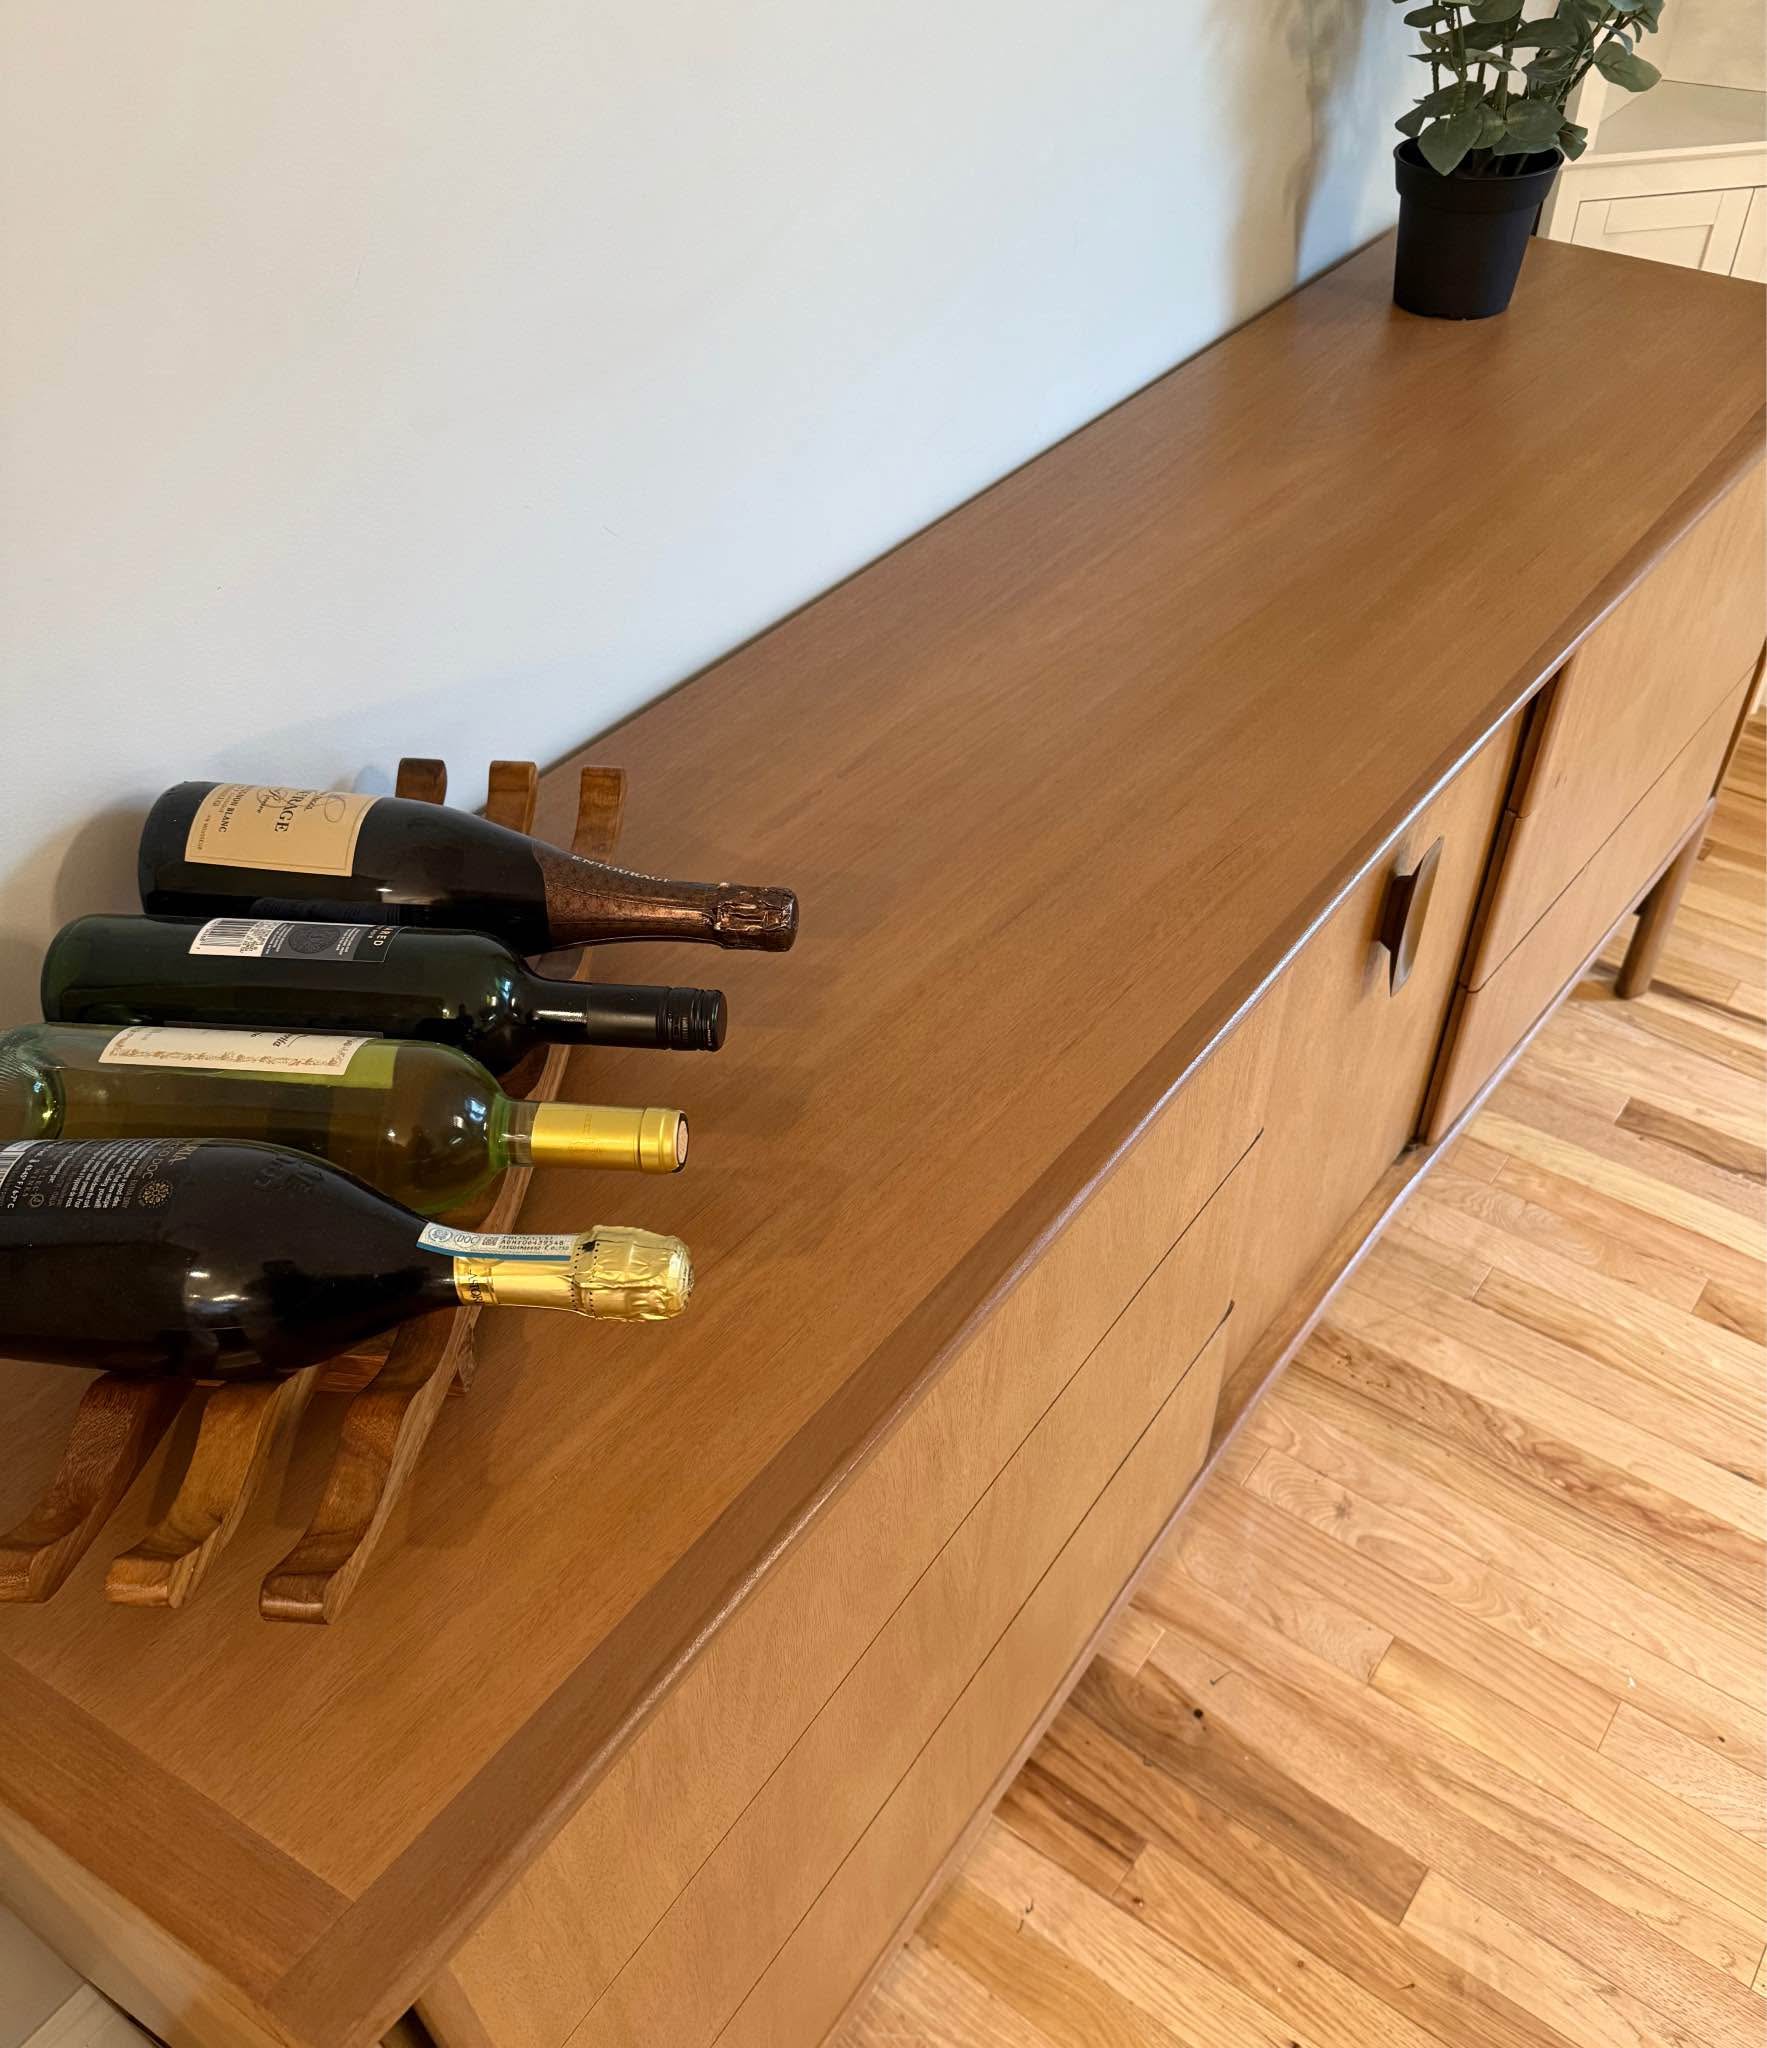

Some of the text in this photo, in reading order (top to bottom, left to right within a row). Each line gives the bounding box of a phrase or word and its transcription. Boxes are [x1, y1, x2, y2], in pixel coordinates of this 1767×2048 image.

[142, 1158, 165, 1180] DOC
[457, 1234, 479, 1244] DOC
[468, 1268, 484, 1304] ASTORI
